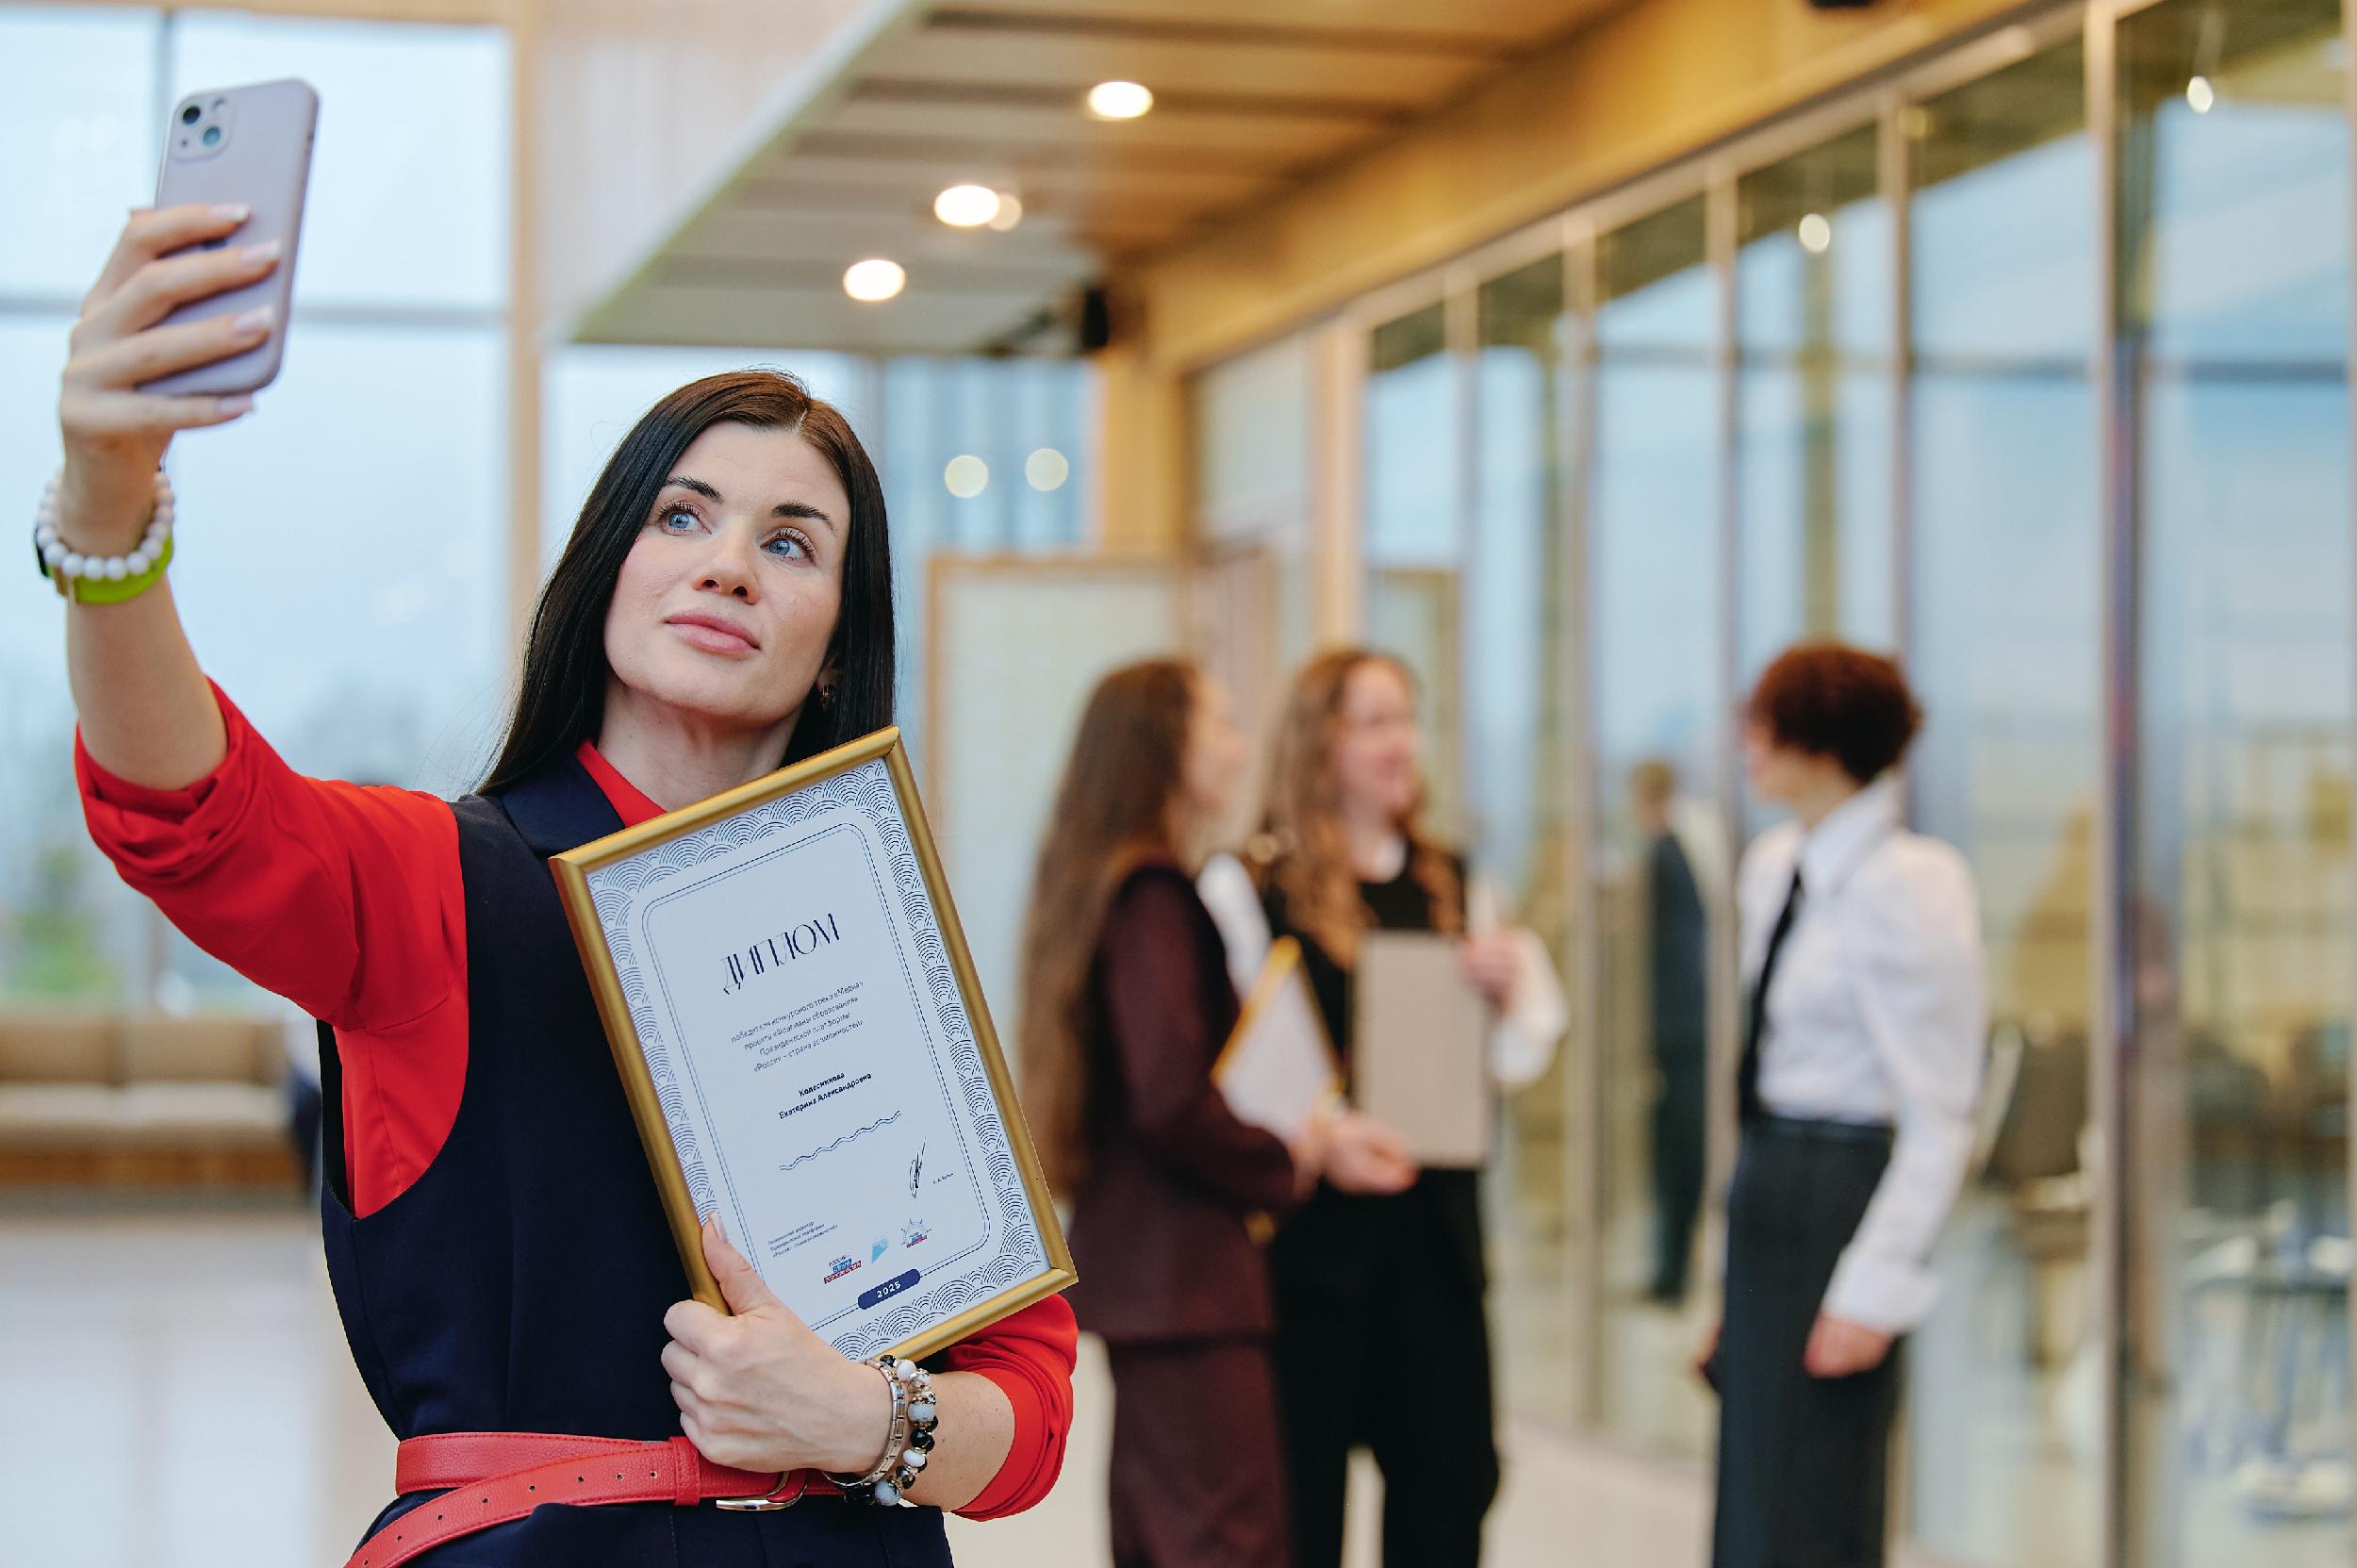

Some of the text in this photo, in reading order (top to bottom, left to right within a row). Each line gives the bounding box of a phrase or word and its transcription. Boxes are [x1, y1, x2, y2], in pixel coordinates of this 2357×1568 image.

[720, 913, 841, 995] ДИПЛОМ
[744, 1032, 772, 1050] проекта
[788, 1043, 812, 1057] страна
[799, 1072, 845, 1097] Колесникова
[779, 1073, 872, 1119] Екатерина Александровна
[876, 1280, 901, 1298] 2025
